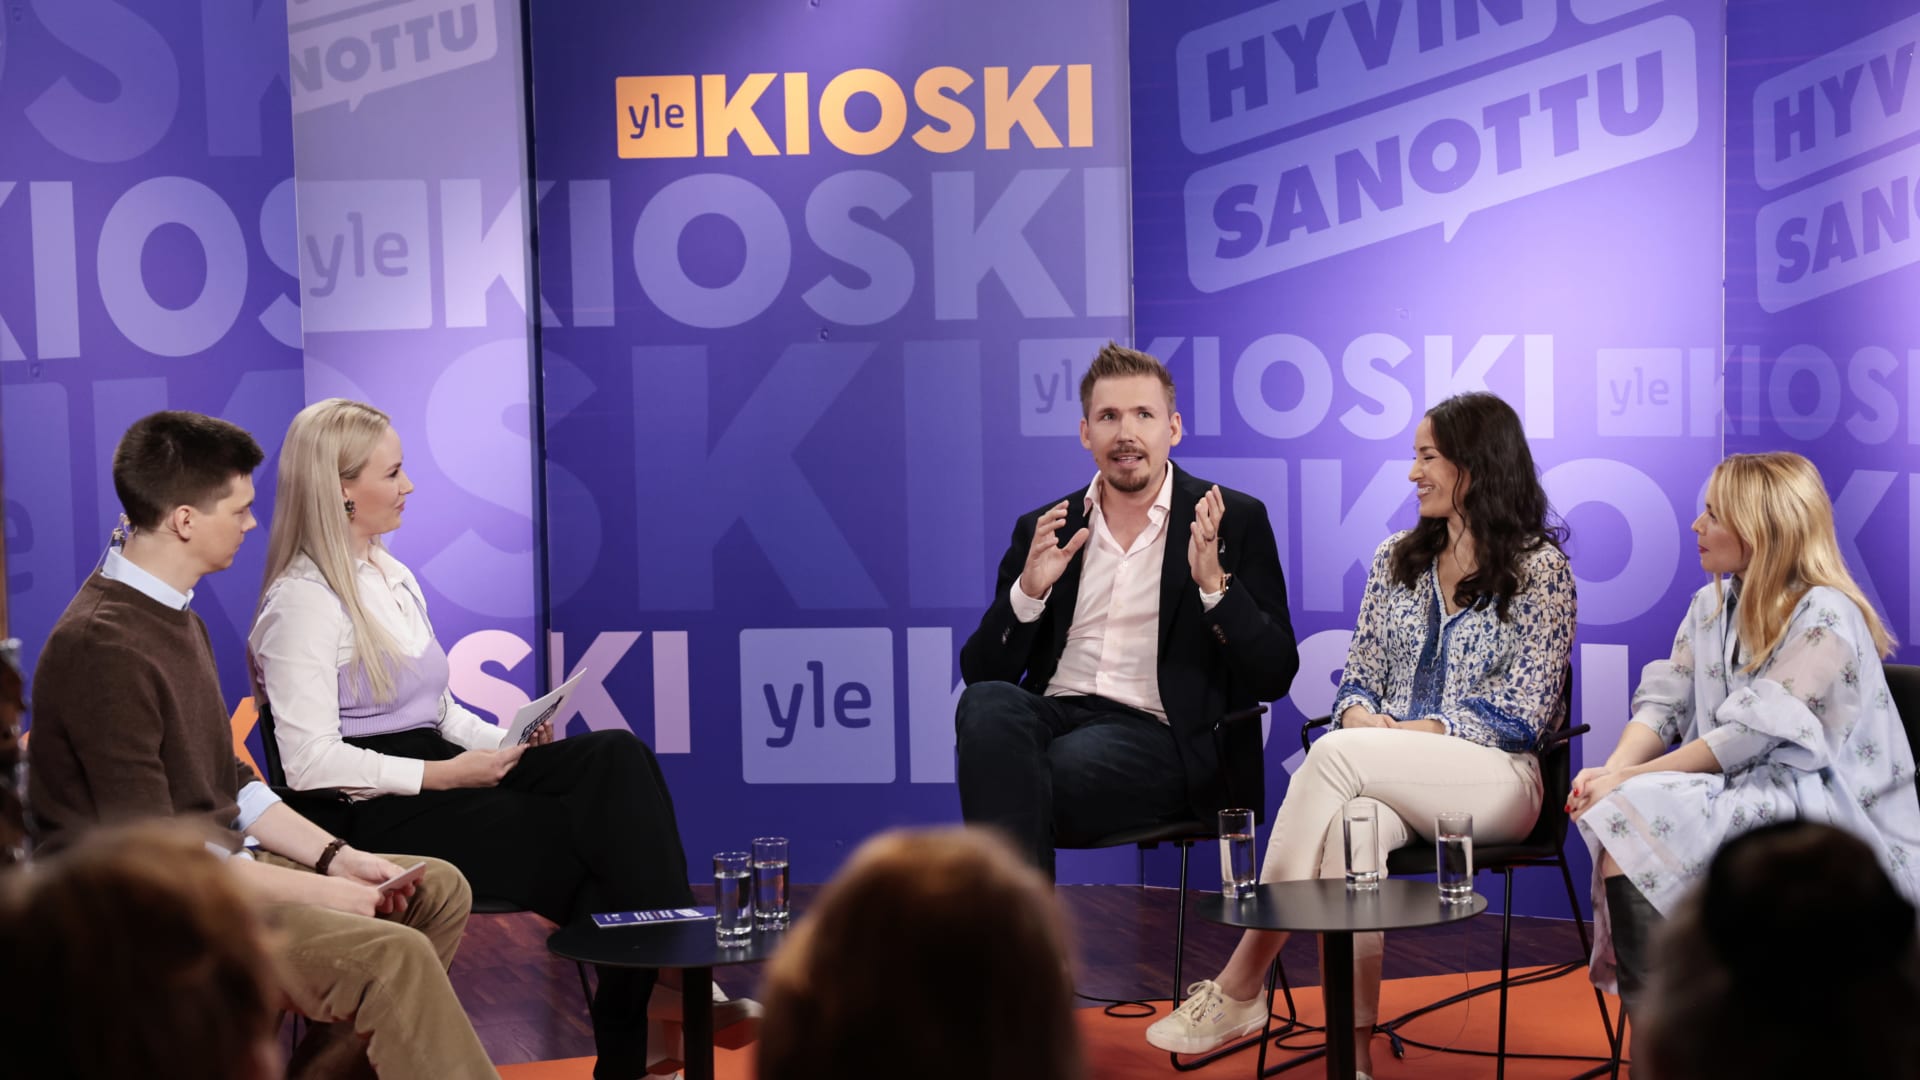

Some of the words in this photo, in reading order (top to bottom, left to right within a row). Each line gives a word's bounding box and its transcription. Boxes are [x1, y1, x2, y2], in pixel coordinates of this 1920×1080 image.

[628, 93, 685, 139] yle
[701, 64, 1094, 158] KIOSKI
[1212, 50, 1665, 260] SANOTTU
[305, 212, 409, 298] yle
[1775, 175, 1920, 284] SAN
[1609, 367, 1670, 416] yle
[763, 660, 872, 748] yle
